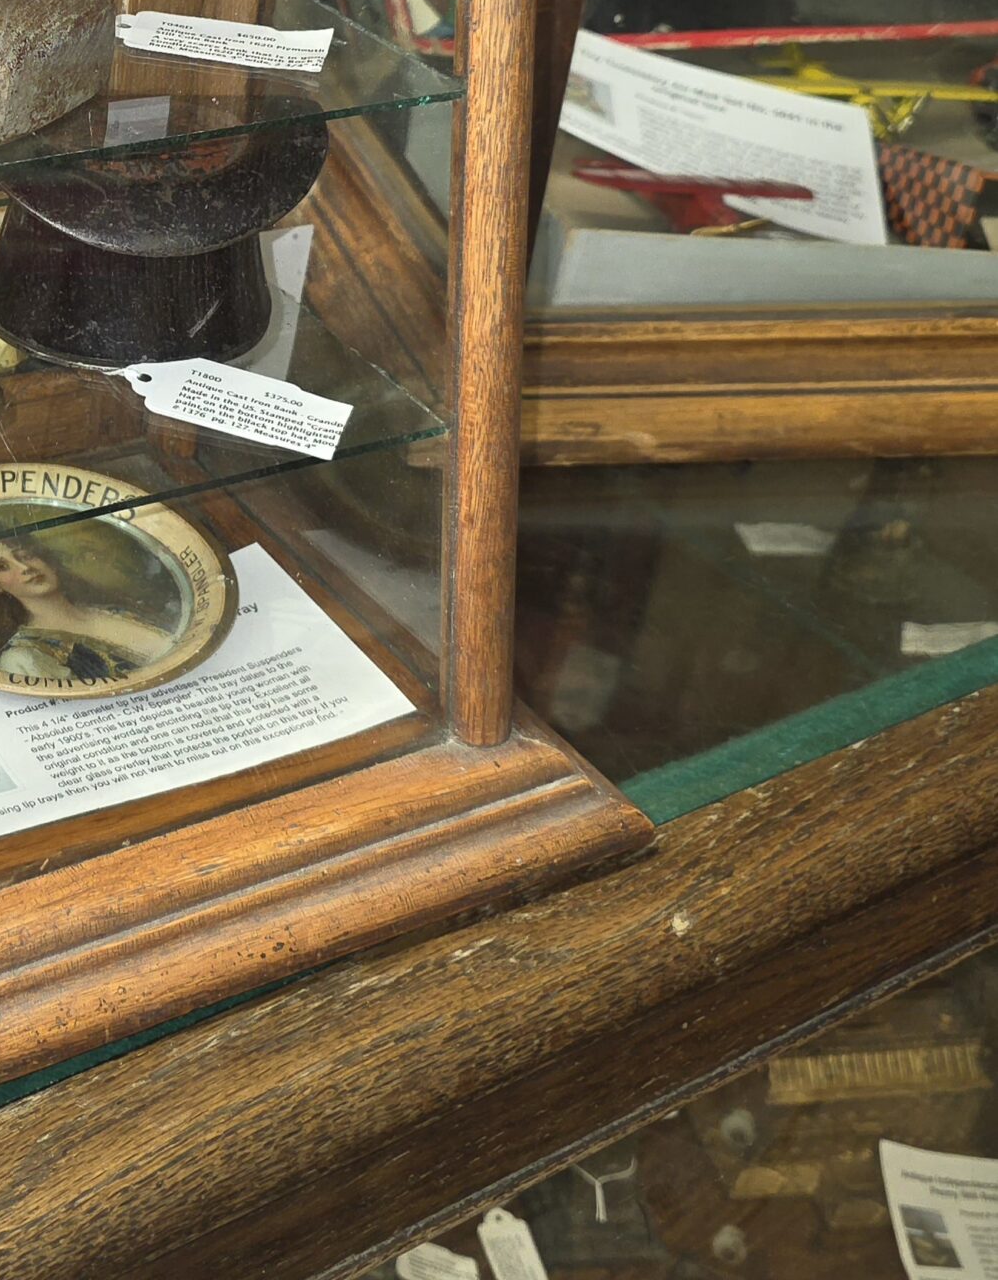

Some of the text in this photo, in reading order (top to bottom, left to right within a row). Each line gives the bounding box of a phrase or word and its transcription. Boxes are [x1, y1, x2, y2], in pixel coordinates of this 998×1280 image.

[182, 386, 208, 397] Made
[224, 398, 239, 406] the
[242, 404, 256, 412] US.
[260, 409, 304, 426] Stamped
[183, 407, 206, 418] 1376
[254, 429, 301, 446] Measures
[185, 379, 223, 393] Antique
[226, 391, 248, 401] Cast
[251, 398, 271, 407] Iron
[273, 405, 297, 416] Bank
[219, 411, 234, 419] the
[271, 427, 287, 435] top
[291, 432, 308, 442] hat.
[237, 409, 274, 424] bottom
[277, 421, 336, 441] highlighted
[264, 392, 303, 407] $375.00
[180, 545, 210, 614] SPANGLER
[5, 702, 48, 718] Product
[16, 723, 40, 735] This
[72, 704, 114, 720] diameter
[117, 699, 129, 709] tip
[131, 694, 149, 707] tray
[152, 680, 199, 698] advertises
[246, 646, 302, 670] Suspenders
[31, 726, 73, 742] Absolute
[75, 713, 116, 729] Comfort
[123, 704, 147, 716] C.W.
[197, 685, 218, 696] This
[219, 679, 238, 692] tray
[239, 671, 265, 683] dates
[277, 660, 294, 671] the
[31, 743, 56, 754] early
[96, 726, 118, 738] This
[119, 718, 137, 730] tray
[140, 706, 174, 722] depicts
[184, 693, 224, 710] beautiful
[226, 683, 256, 700] young
[256, 674, 290, 689] woman
[292, 664, 311, 675] with
[36, 675, 310, 762] the advertising wordage encircling the tip tray. Excellent all
[44, 684, 318, 771] original condition and one can note that this tray has some
[23, 798, 36, 813] tip
[37, 790, 64, 804] trays
[66, 785, 90, 796] then
[91, 779, 110, 791] you
[112, 774, 129, 784] will
[131, 768, 148, 779] not
[150, 762, 174, 774] want
[174, 759, 185, 767] to
[186, 751, 210, 764] miss
[212, 746, 229, 757] out
[229, 742, 242, 751] on
[243, 737, 262, 747] this
[262, 718, 317, 742] exceptional
[317, 711, 338, 724] find.
[50, 699, 312, 779] weight to it as the bottom is covered and protected with
[58, 695, 348, 789] clear glass overlay that protects the portrait on this tray. you
